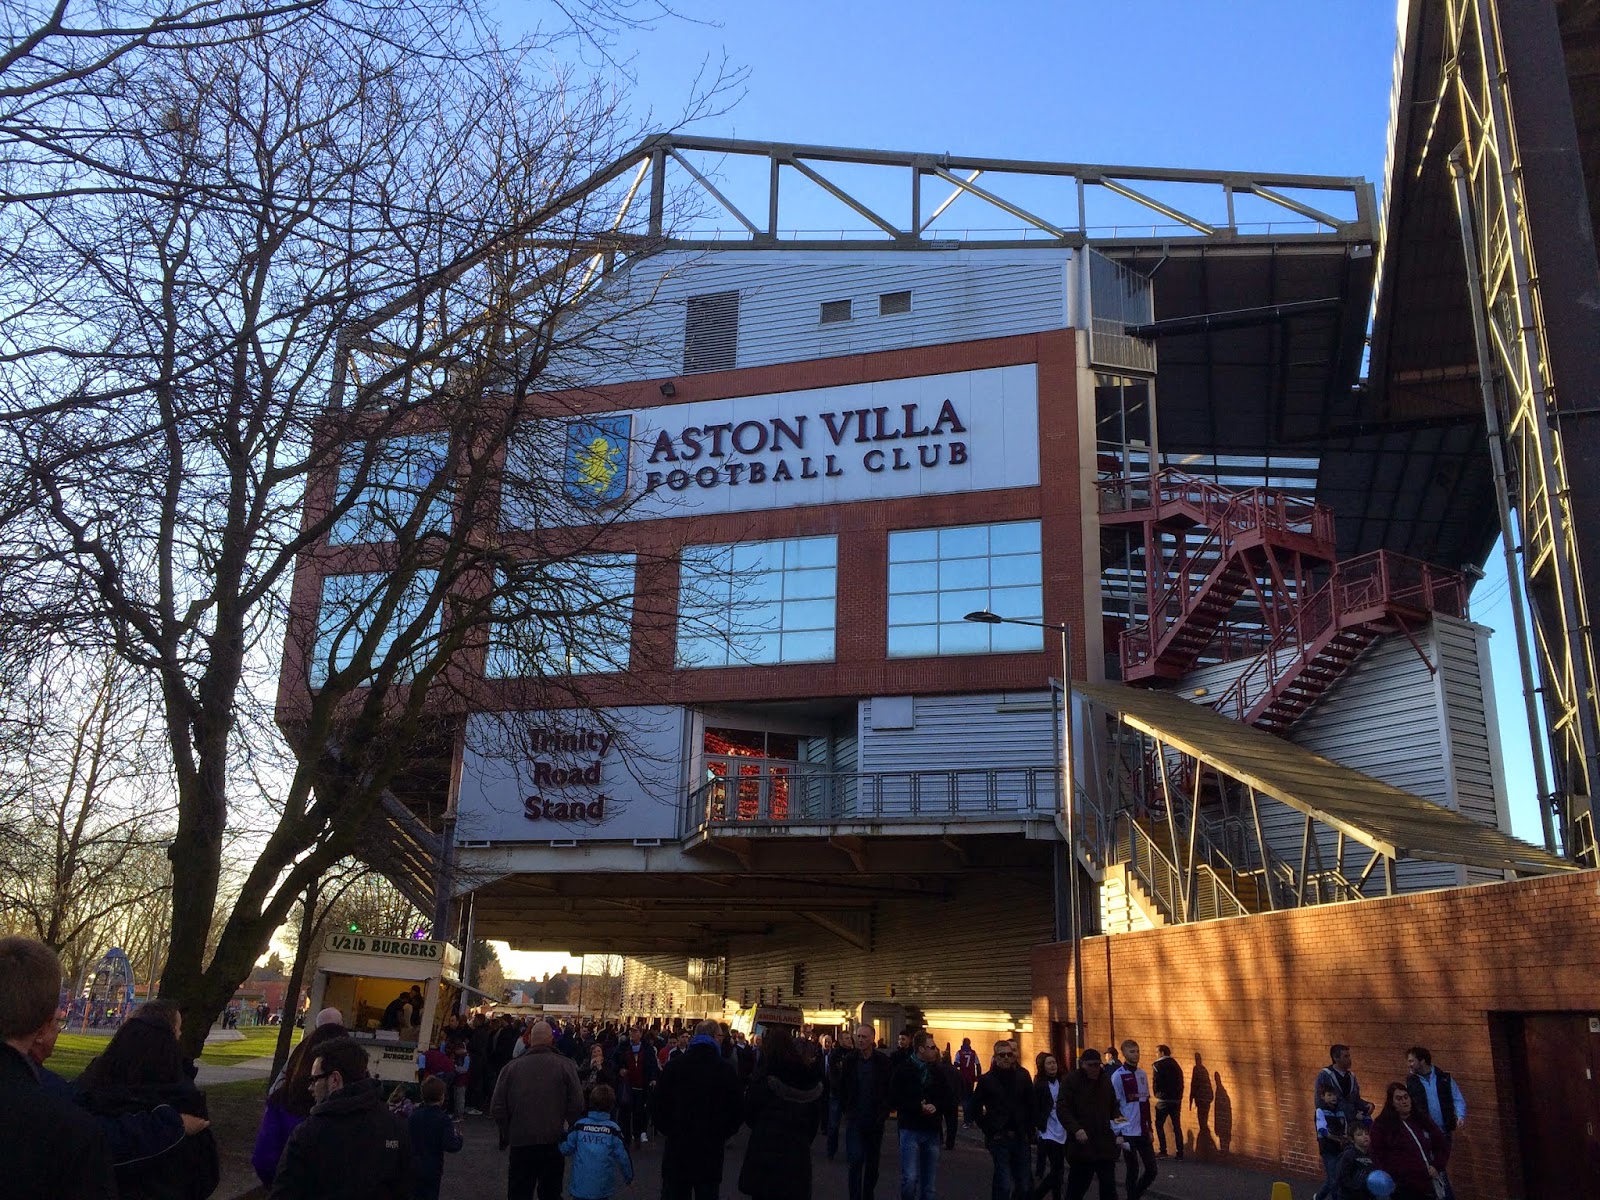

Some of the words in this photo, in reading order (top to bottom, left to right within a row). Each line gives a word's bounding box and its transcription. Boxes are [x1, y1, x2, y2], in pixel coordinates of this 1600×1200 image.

[647, 415, 808, 464] ASTON
[819, 398, 967, 446] VILLA
[646, 454, 843, 493] FOOTBALL
[863, 441, 969, 473] CLUB
[529, 727, 614, 757] Trinity
[533, 760, 602, 786] Road
[524, 794, 605, 820] Stand
[371, 940, 437, 958] BURGERS
[758, 1012, 802, 1024] AMBULANCE
[964, 1054, 971, 1067] 7
[581, 1134, 607, 1145] AVFC
[583, 1125, 611, 1134] macron
